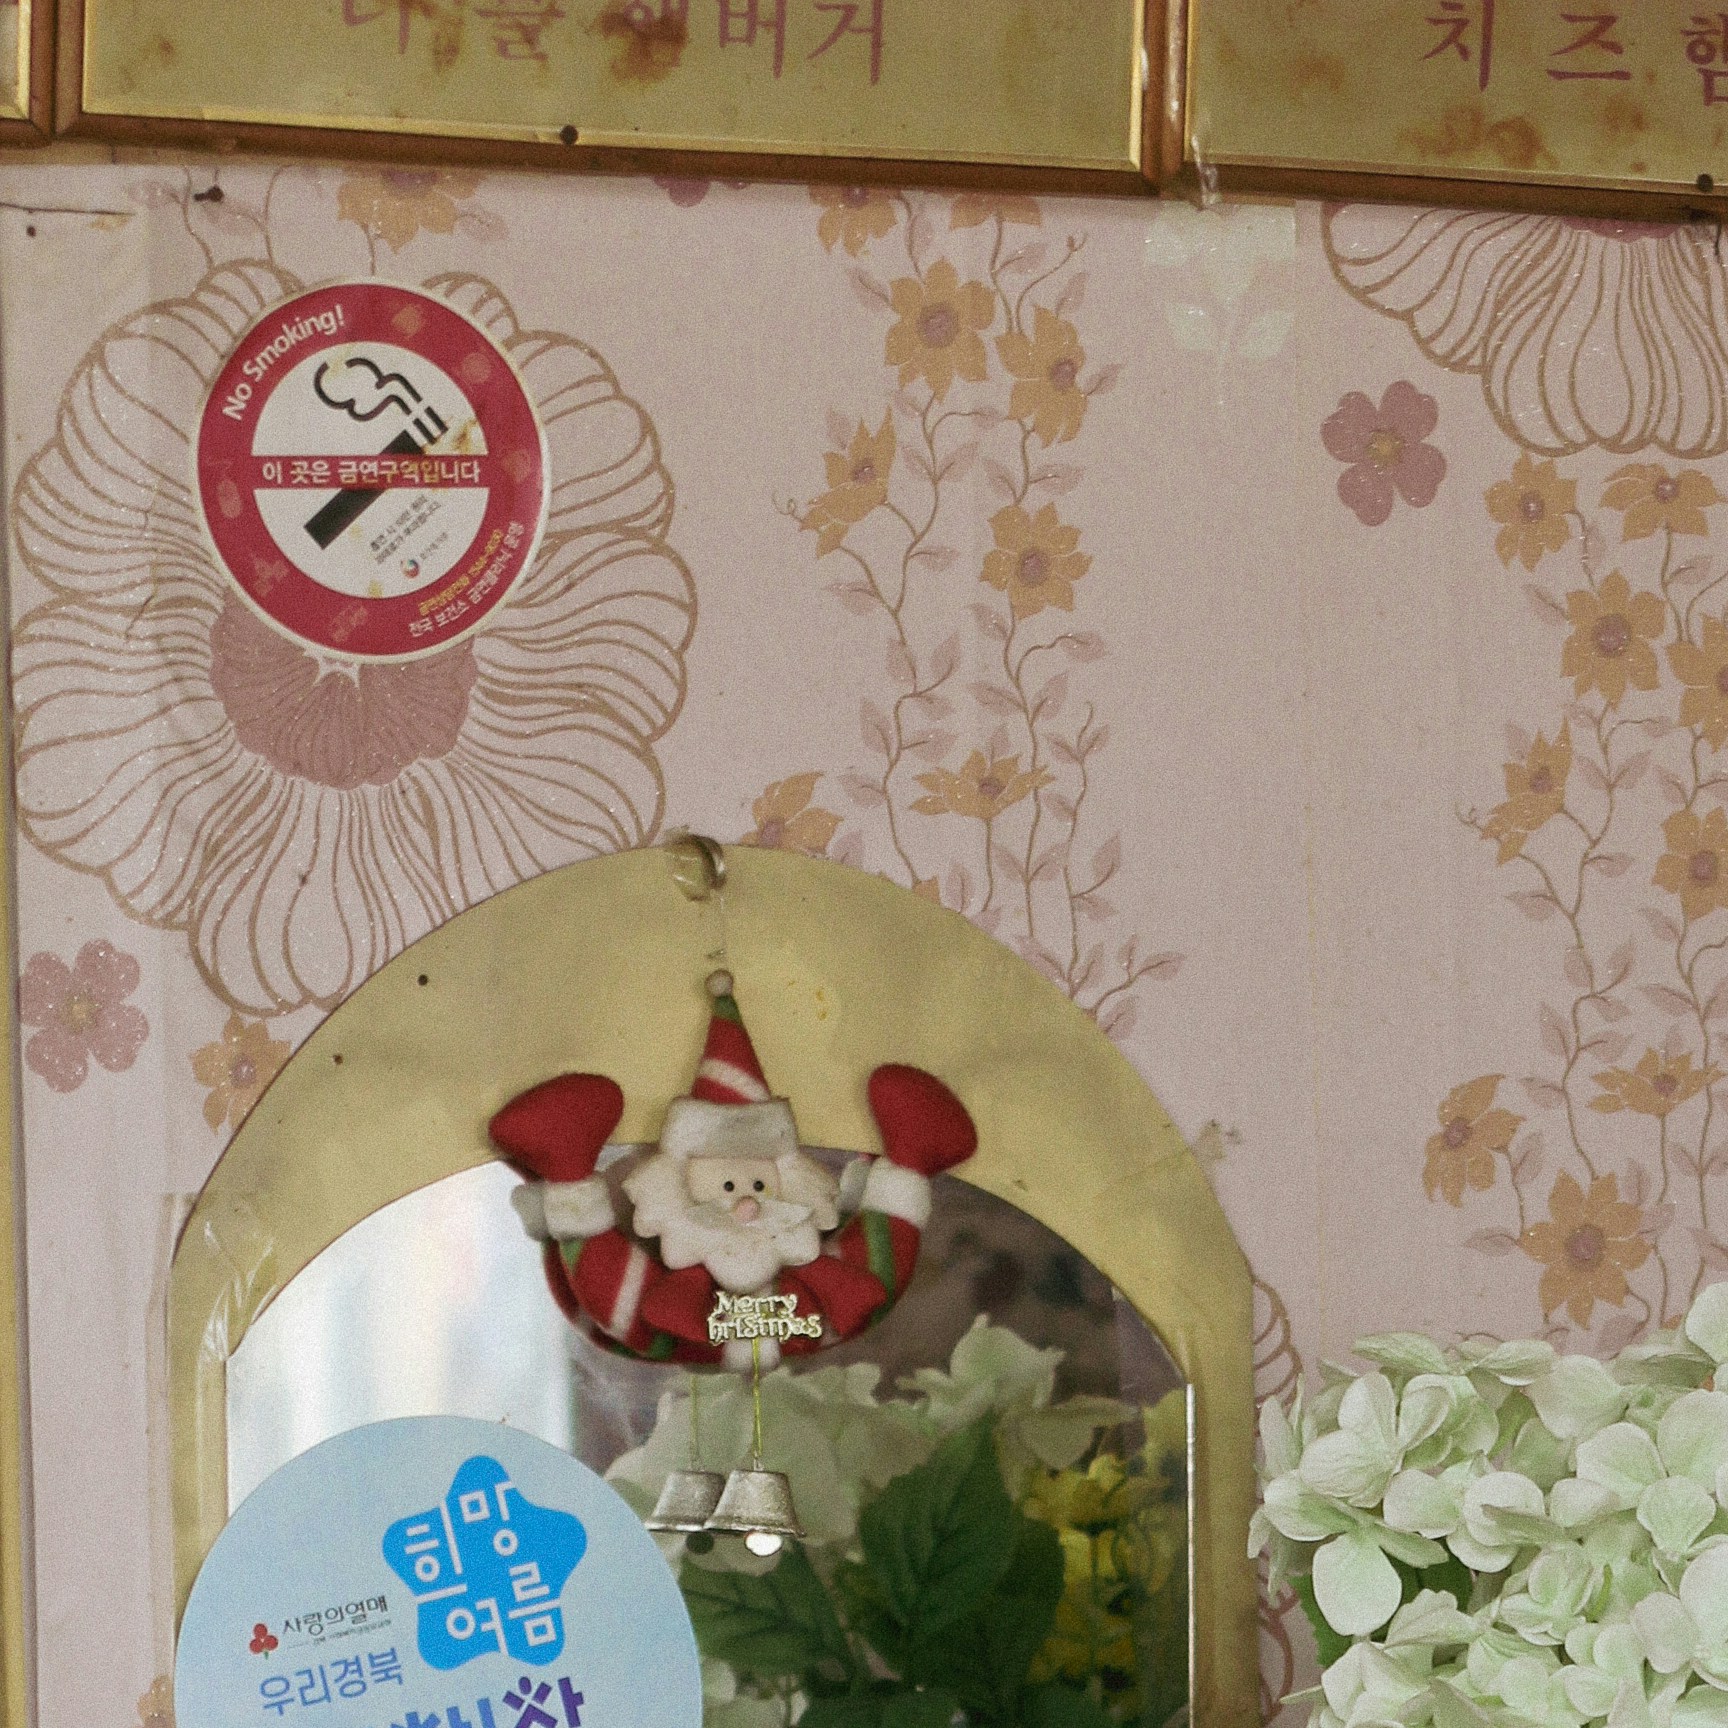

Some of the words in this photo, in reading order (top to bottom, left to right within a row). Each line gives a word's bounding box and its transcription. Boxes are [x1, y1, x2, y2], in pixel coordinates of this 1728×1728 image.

[222, 382, 253, 421] No
[242, 304, 345, 383] Smoking!
[261, 461, 283, 484] 이
[290, 461, 331, 484] 곳은
[337, 460, 481, 484] 금연구역입니다
[713, 1290, 798, 1316] Merry
[403, 1481, 520, 1604] 희망
[283, 1594, 389, 1638] 사랑의열매
[444, 1562, 563, 1658] 여름
[258, 1646, 405, 1716] 우리경북
